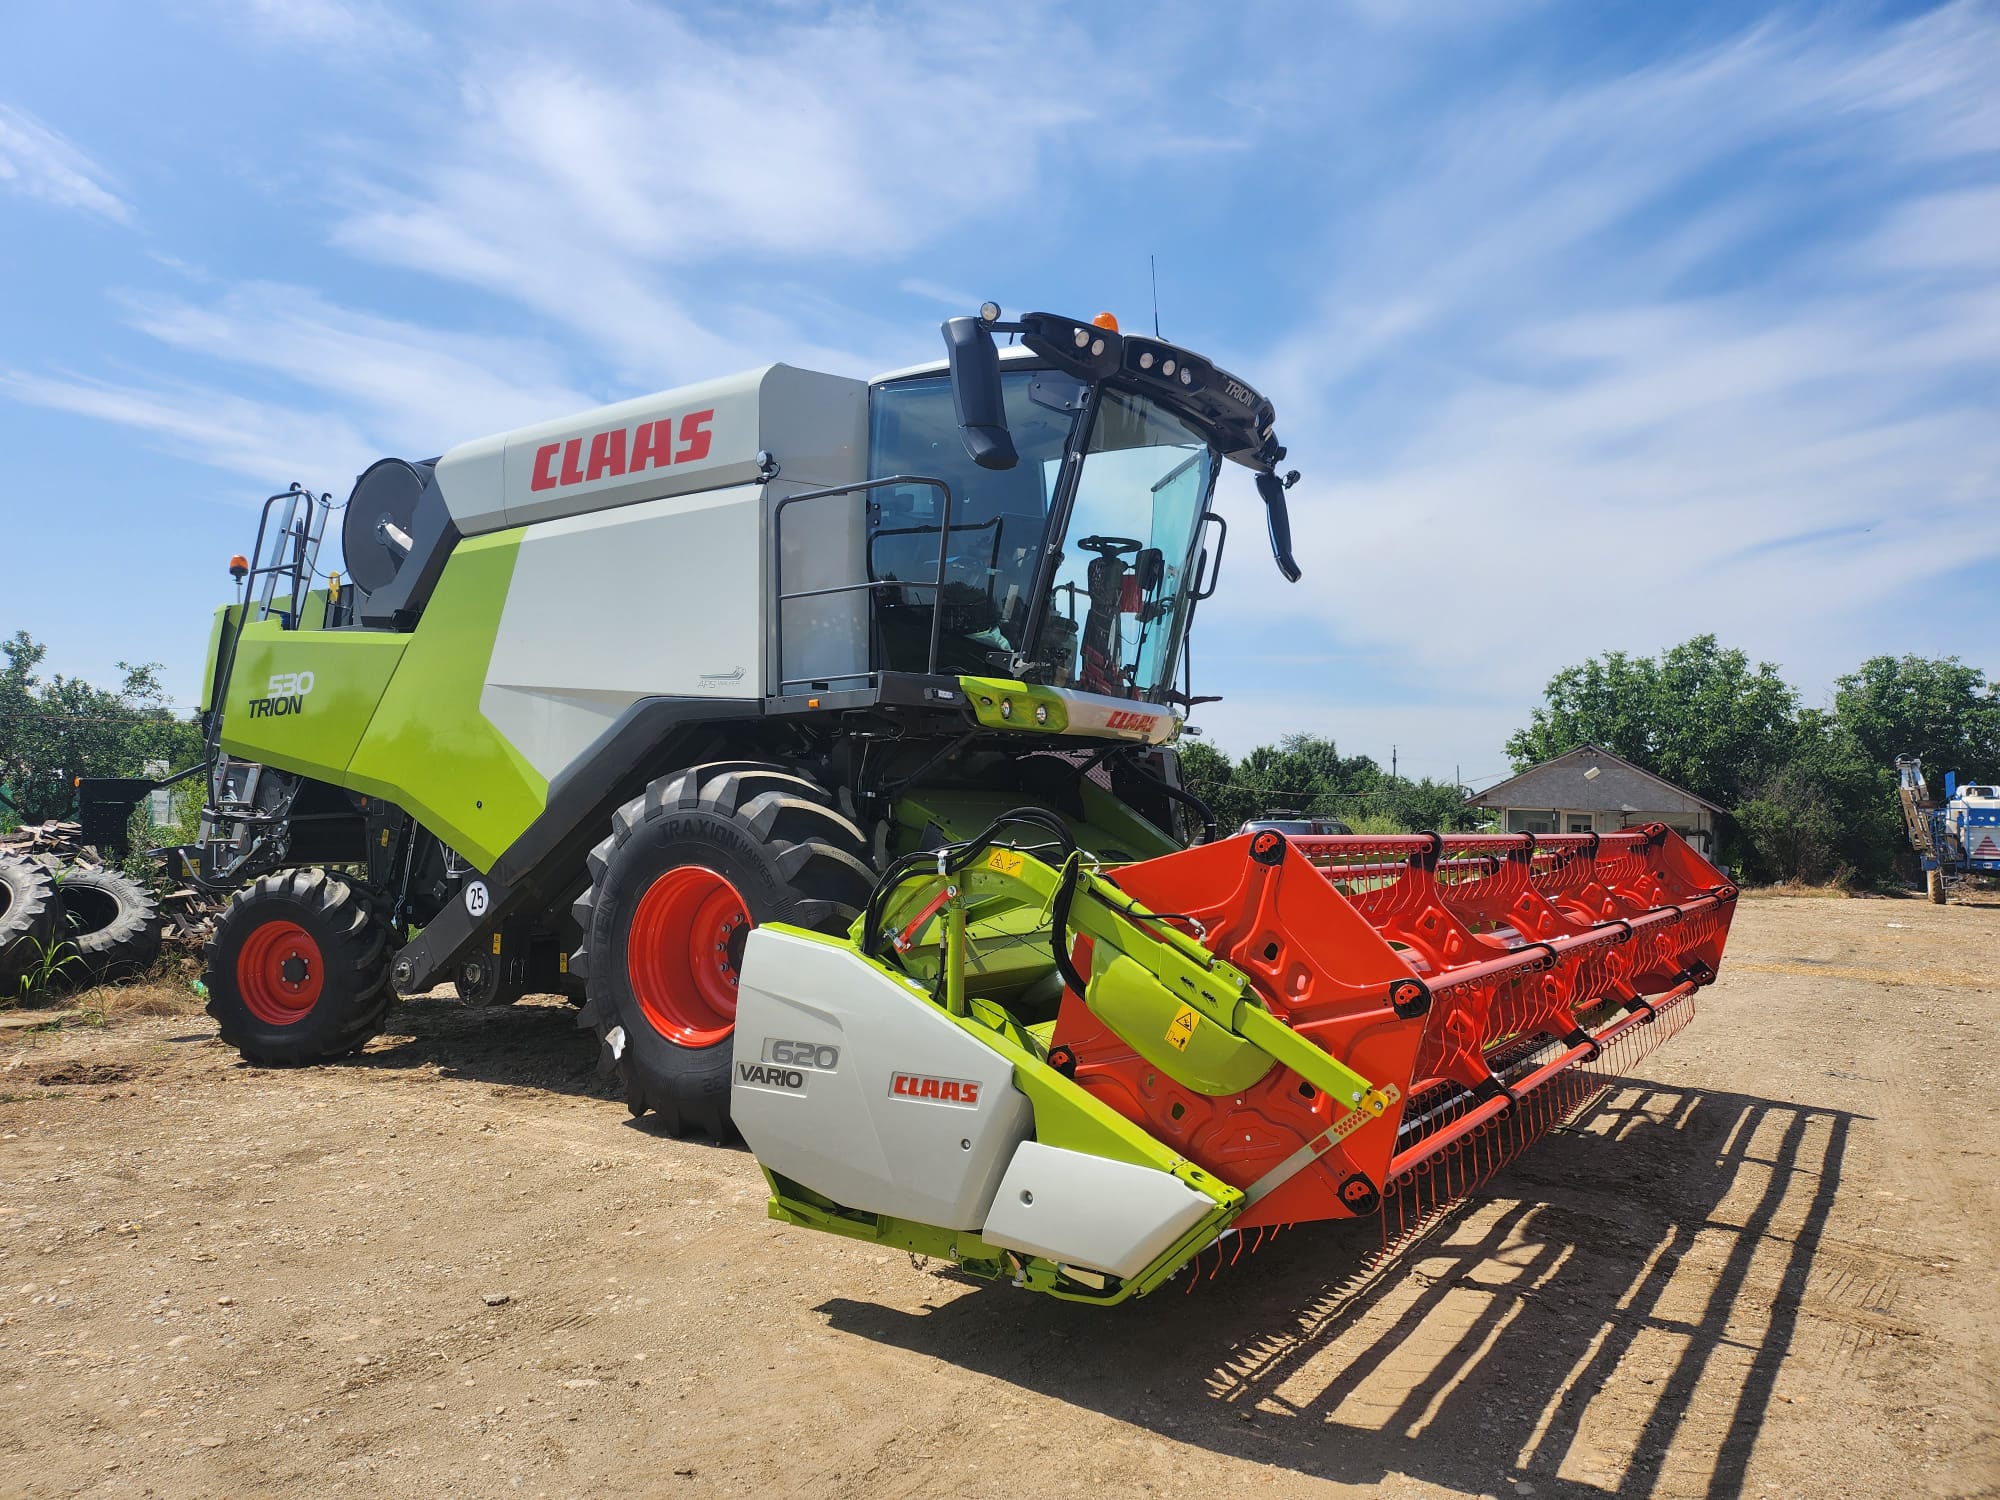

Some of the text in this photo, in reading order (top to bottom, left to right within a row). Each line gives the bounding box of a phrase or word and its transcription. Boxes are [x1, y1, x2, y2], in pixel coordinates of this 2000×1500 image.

[1225, 380, 1256, 407] TRION
[531, 408, 714, 492] CLAAS
[267, 671, 315, 698] 530
[248, 694, 304, 719] TRION
[1105, 710, 1160, 733] CLAAS
[658, 818, 740, 850] TRAXION
[471, 887, 484, 910] 25
[772, 1040, 839, 1070] 620
[739, 1063, 804, 1089] VARIO
[893, 1075, 979, 1103] CLAAS
